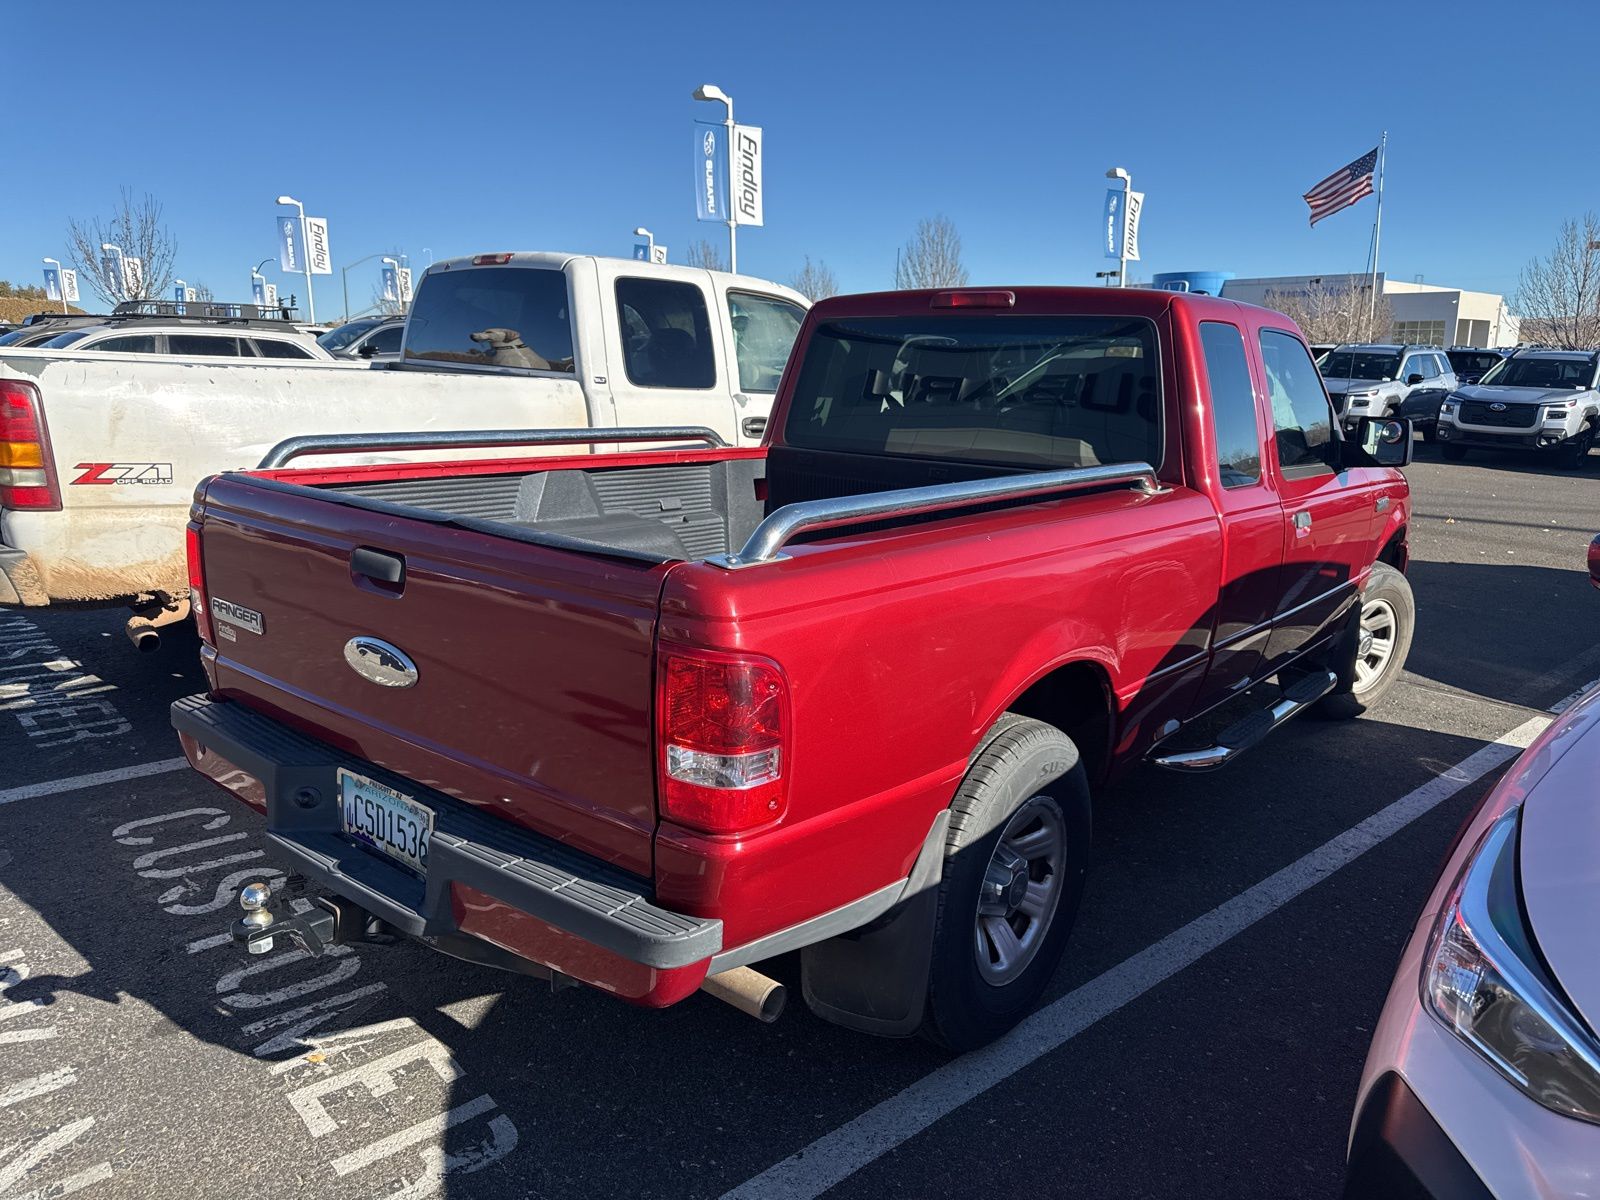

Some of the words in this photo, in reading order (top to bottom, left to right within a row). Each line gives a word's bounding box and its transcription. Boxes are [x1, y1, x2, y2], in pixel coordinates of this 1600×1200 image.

[705, 160, 716, 214] SUBARU
[738, 133, 758, 219] Findlay
[309, 222, 328, 271] Findlay
[1127, 195, 1140, 256] Findlay
[69, 463, 173, 485] Z71
[212, 598, 260, 627] RANGER
[364, 786, 410, 812] ARIZONA
[354, 794, 429, 869] CSD1536
